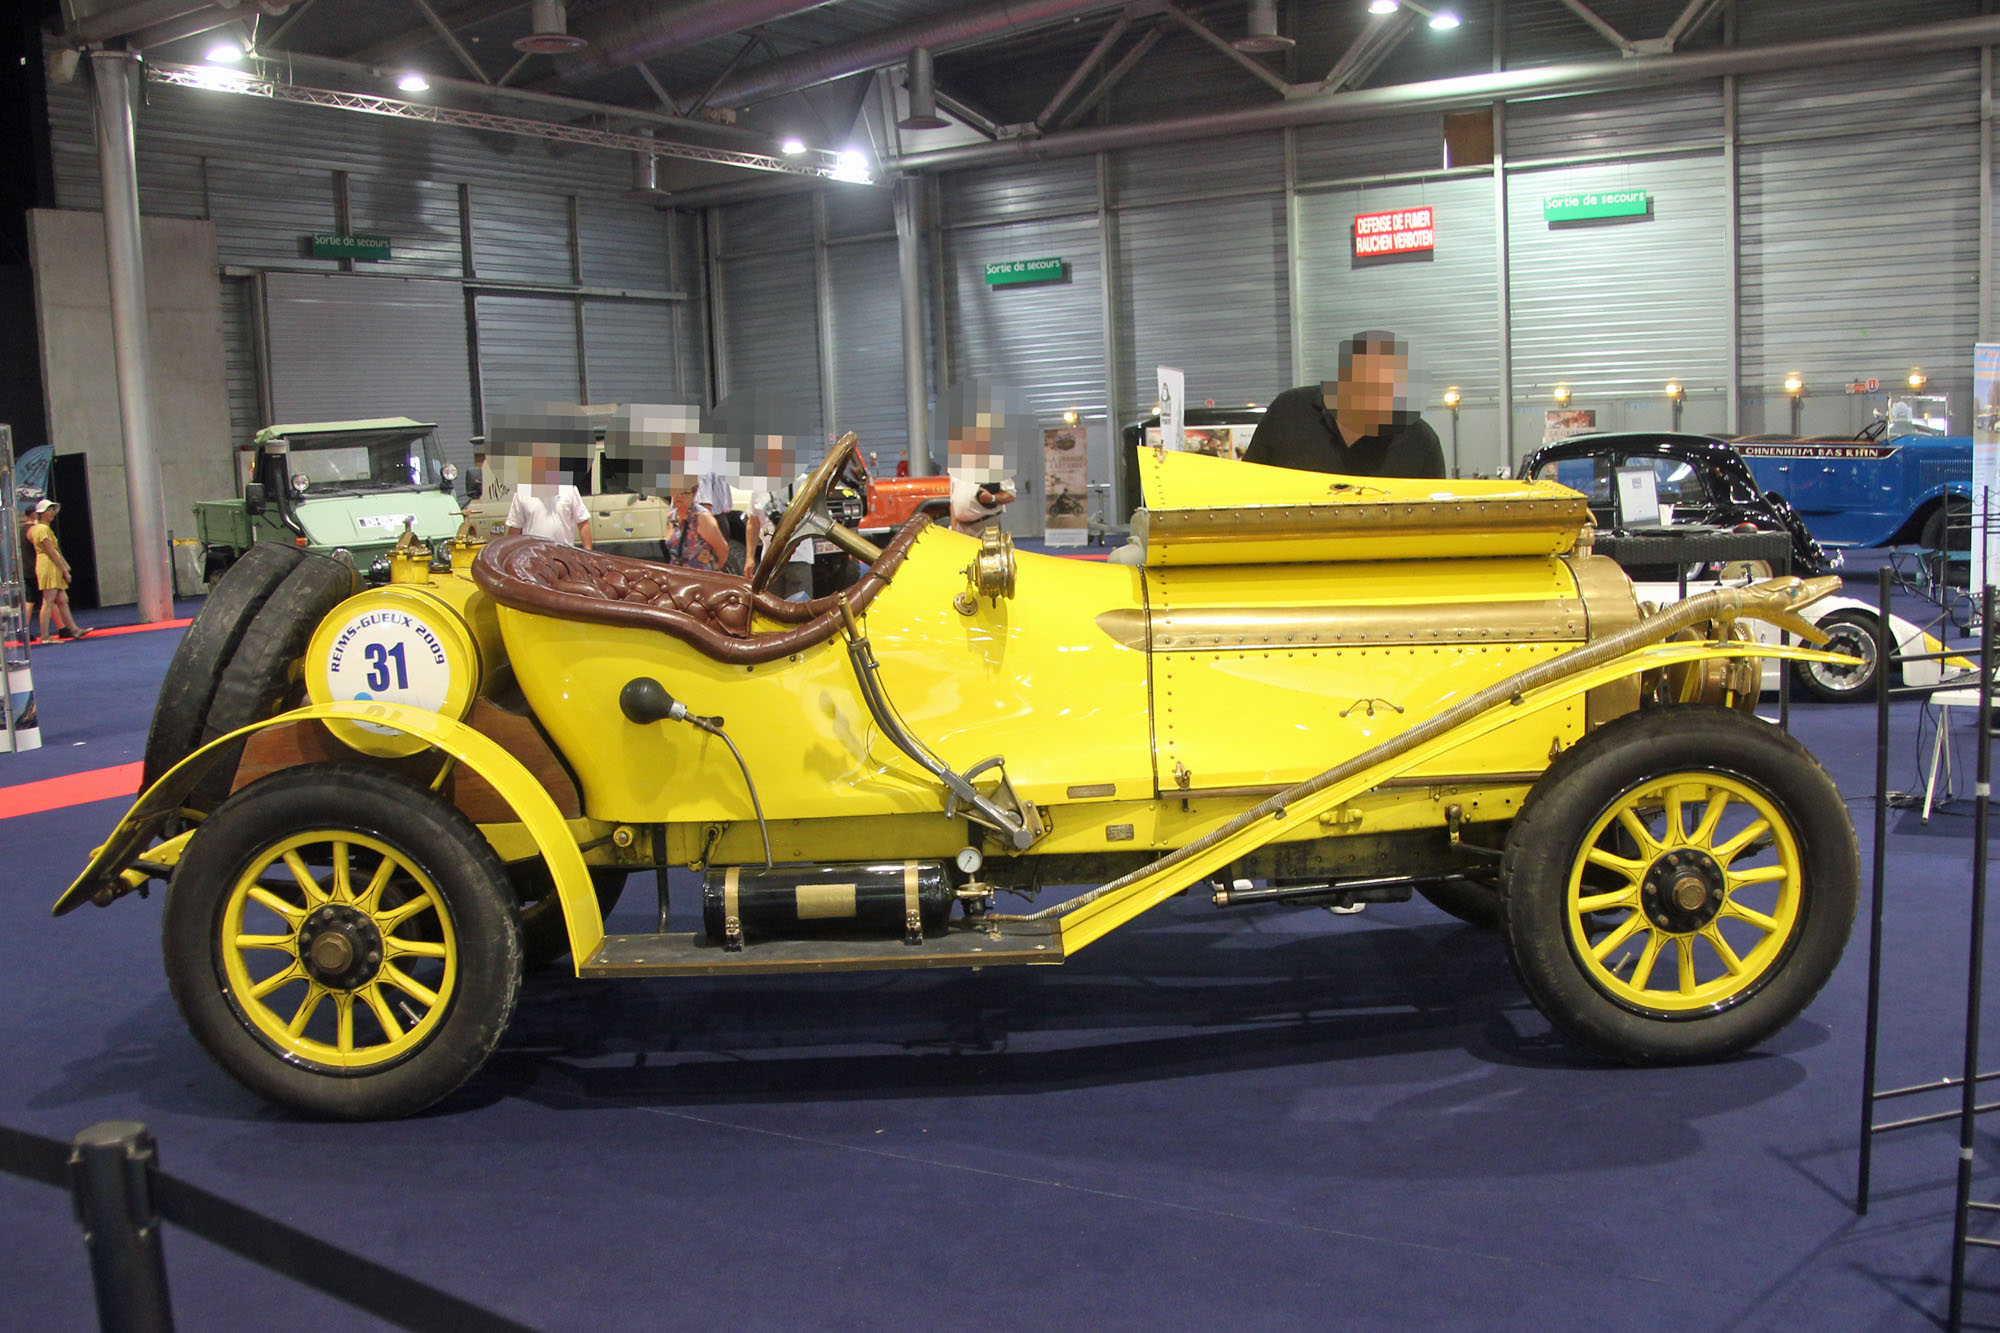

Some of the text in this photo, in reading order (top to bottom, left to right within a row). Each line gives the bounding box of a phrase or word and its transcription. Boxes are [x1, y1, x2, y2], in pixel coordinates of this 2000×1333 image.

[1545, 192, 1645, 210] Sortie de secours
[1357, 210, 1431, 235] DEFENSE DE FUMER
[313, 232, 389, 248] Sortie de secours
[1356, 229, 1433, 253] RAUCHEN VERBOTEN
[986, 260, 1060, 275] Sortie de secours
[1745, 447, 1813, 456] OHNENHEIM
[1818, 448, 1842, 457] BAS
[1846, 447, 1879, 457] RHIN
[331, 613, 445, 673] REIMS-GUEUX 2009
[364, 642, 409, 692] 31
